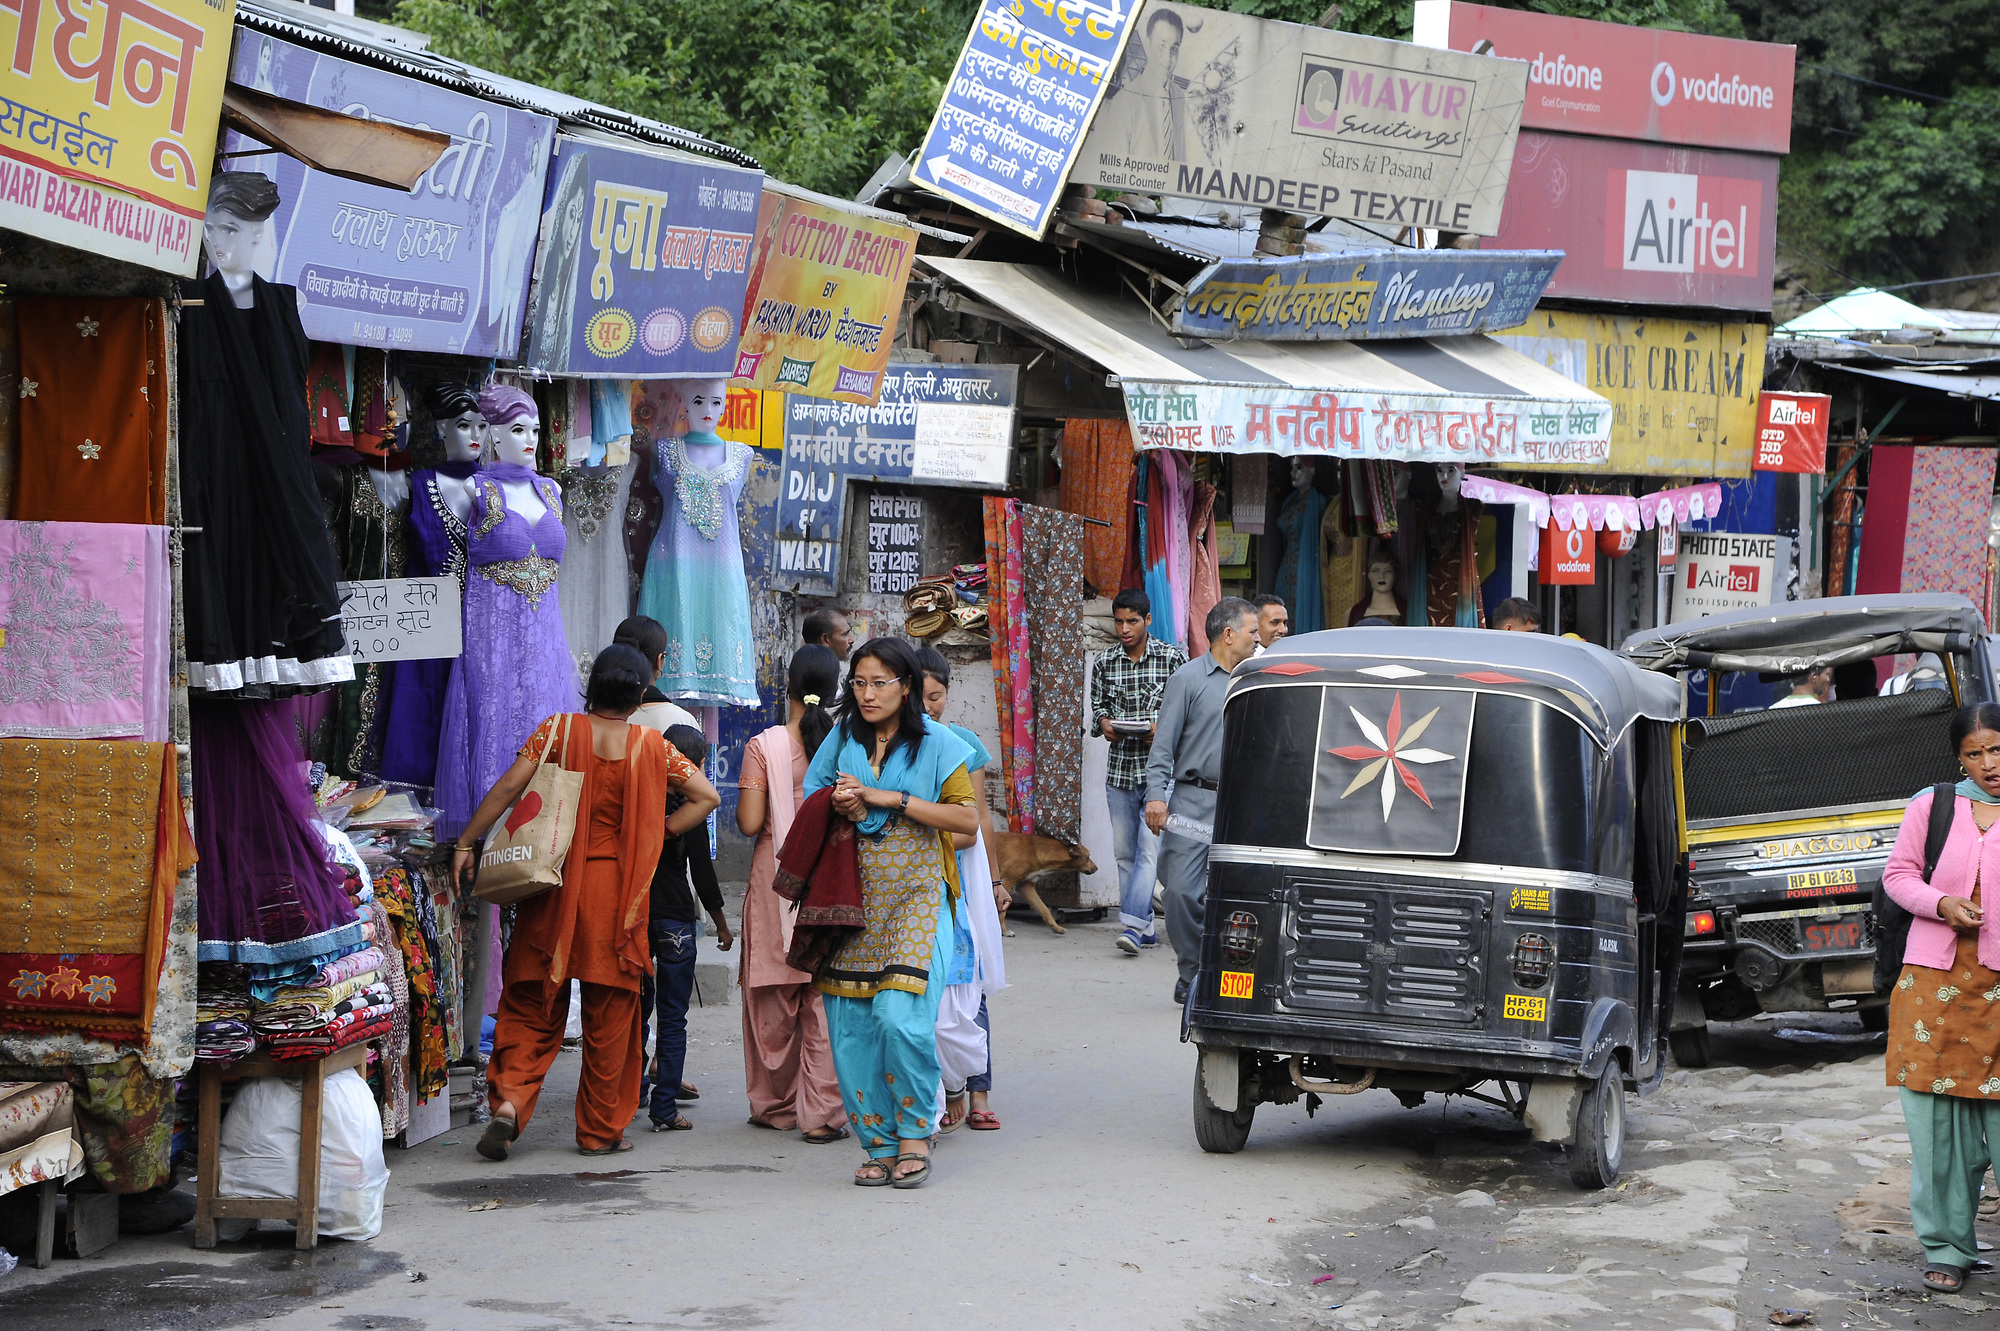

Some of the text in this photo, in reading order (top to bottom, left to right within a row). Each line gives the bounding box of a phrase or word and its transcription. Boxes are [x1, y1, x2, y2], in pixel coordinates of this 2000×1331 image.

[980, 5, 1026, 50] की
[1020, 27, 1111, 86] दुकान
[964, 47, 1091, 117] दुपट्टे की डाई केवल
[1502, 53, 1603, 91] dafone
[1345, 69, 1467, 122] MAYUR
[1682, 72, 1774, 109] vodafone
[1018, 100, 1037, 127] की
[1034, 109, 1066, 139] जाती
[1337, 114, 1462, 150] Suitings
[941, 102, 1065, 175] दुपट्टे की सिंगल डाई
[969, 142, 989, 165] की
[987, 154, 1021, 179] जाती
[1099, 153, 1170, 174] Mills Approved
[1321, 147, 1434, 181] Stars ki Pasand
[1099, 170, 1167, 190] Retail Counter
[1176, 163, 1473, 230] MANDEEP TEXTILE
[43, 174, 102, 229] BAZAR
[103, 196, 156, 243] KULLU
[156, 212, 192, 263] (H.P.)
[331, 202, 463, 262] क्लाथ हाऊस
[1630, 196, 1747, 269] Airtel
[590, 179, 668, 302] पूजा
[662, 225, 754, 281] क्लाथ हाऊस
[781, 213, 911, 285] COTTON BEAUTY
[305, 269, 332, 296] विवाह
[359, 280, 369, 300] के
[390, 289, 402, 305] पर
[401, 286, 419, 308] भारी
[419, 293, 432, 315] छूट
[431, 288, 440, 309] दी
[440, 291, 459, 312] जाती
[457, 291, 465, 315] है
[822, 281, 839, 299] BY
[1186, 273, 1293, 330] मनदीप
[1377, 268, 1496, 328] Mandeep
[599, 321, 623, 348] सूट
[649, 318, 677, 346] साड़ी
[752, 298, 797, 336] FASHION
[794, 306, 832, 341] WORLD
[1426, 312, 1467, 329] TAXTILE
[738, 356, 874, 394] SUIT LEHANGA
[1594, 342, 1746, 399] ICE CREAM
[830, 400, 841, 422] के
[1163, 387, 1198, 421] सेल
[1529, 404, 1600, 436] सेल सेल
[1661, 405, 1675, 430] Ice
[1772, 406, 1816, 425] Airtel
[1245, 393, 1365, 451] मनदीप
[1761, 428, 1785, 442] STD
[789, 424, 917, 468] मनदीप टैक्सट
[1758, 453, 1784, 466] PCO
[1760, 440, 1782, 453] ISD
[787, 470, 836, 503] DAJ
[869, 487, 922, 519] सेल सेल
[780, 539, 833, 573] WARI
[1680, 535, 1776, 559] PHOTO STATE
[1557, 561, 1591, 573] vodafone
[1698, 568, 1753, 591] Airtel
[403, 578, 439, 606] सेल
[1685, 597, 1758, 608] STD ISD PCO
[396, 609, 432, 635] सूट
[479, 845, 533, 869] TTINGEN
[1764, 835, 1873, 859] PIAGGIO
[1520, 888, 1551, 899] HANS ART
[1786, 883, 1858, 899] POWER BRAKE
[1789, 868, 1854, 889] HP 61 0243
[1806, 922, 1861, 951] STOP
[1221, 973, 1253, 997] STOP
[1506, 1007, 1543, 1019] 0061
[1507, 996, 1543, 1009] HP.61
